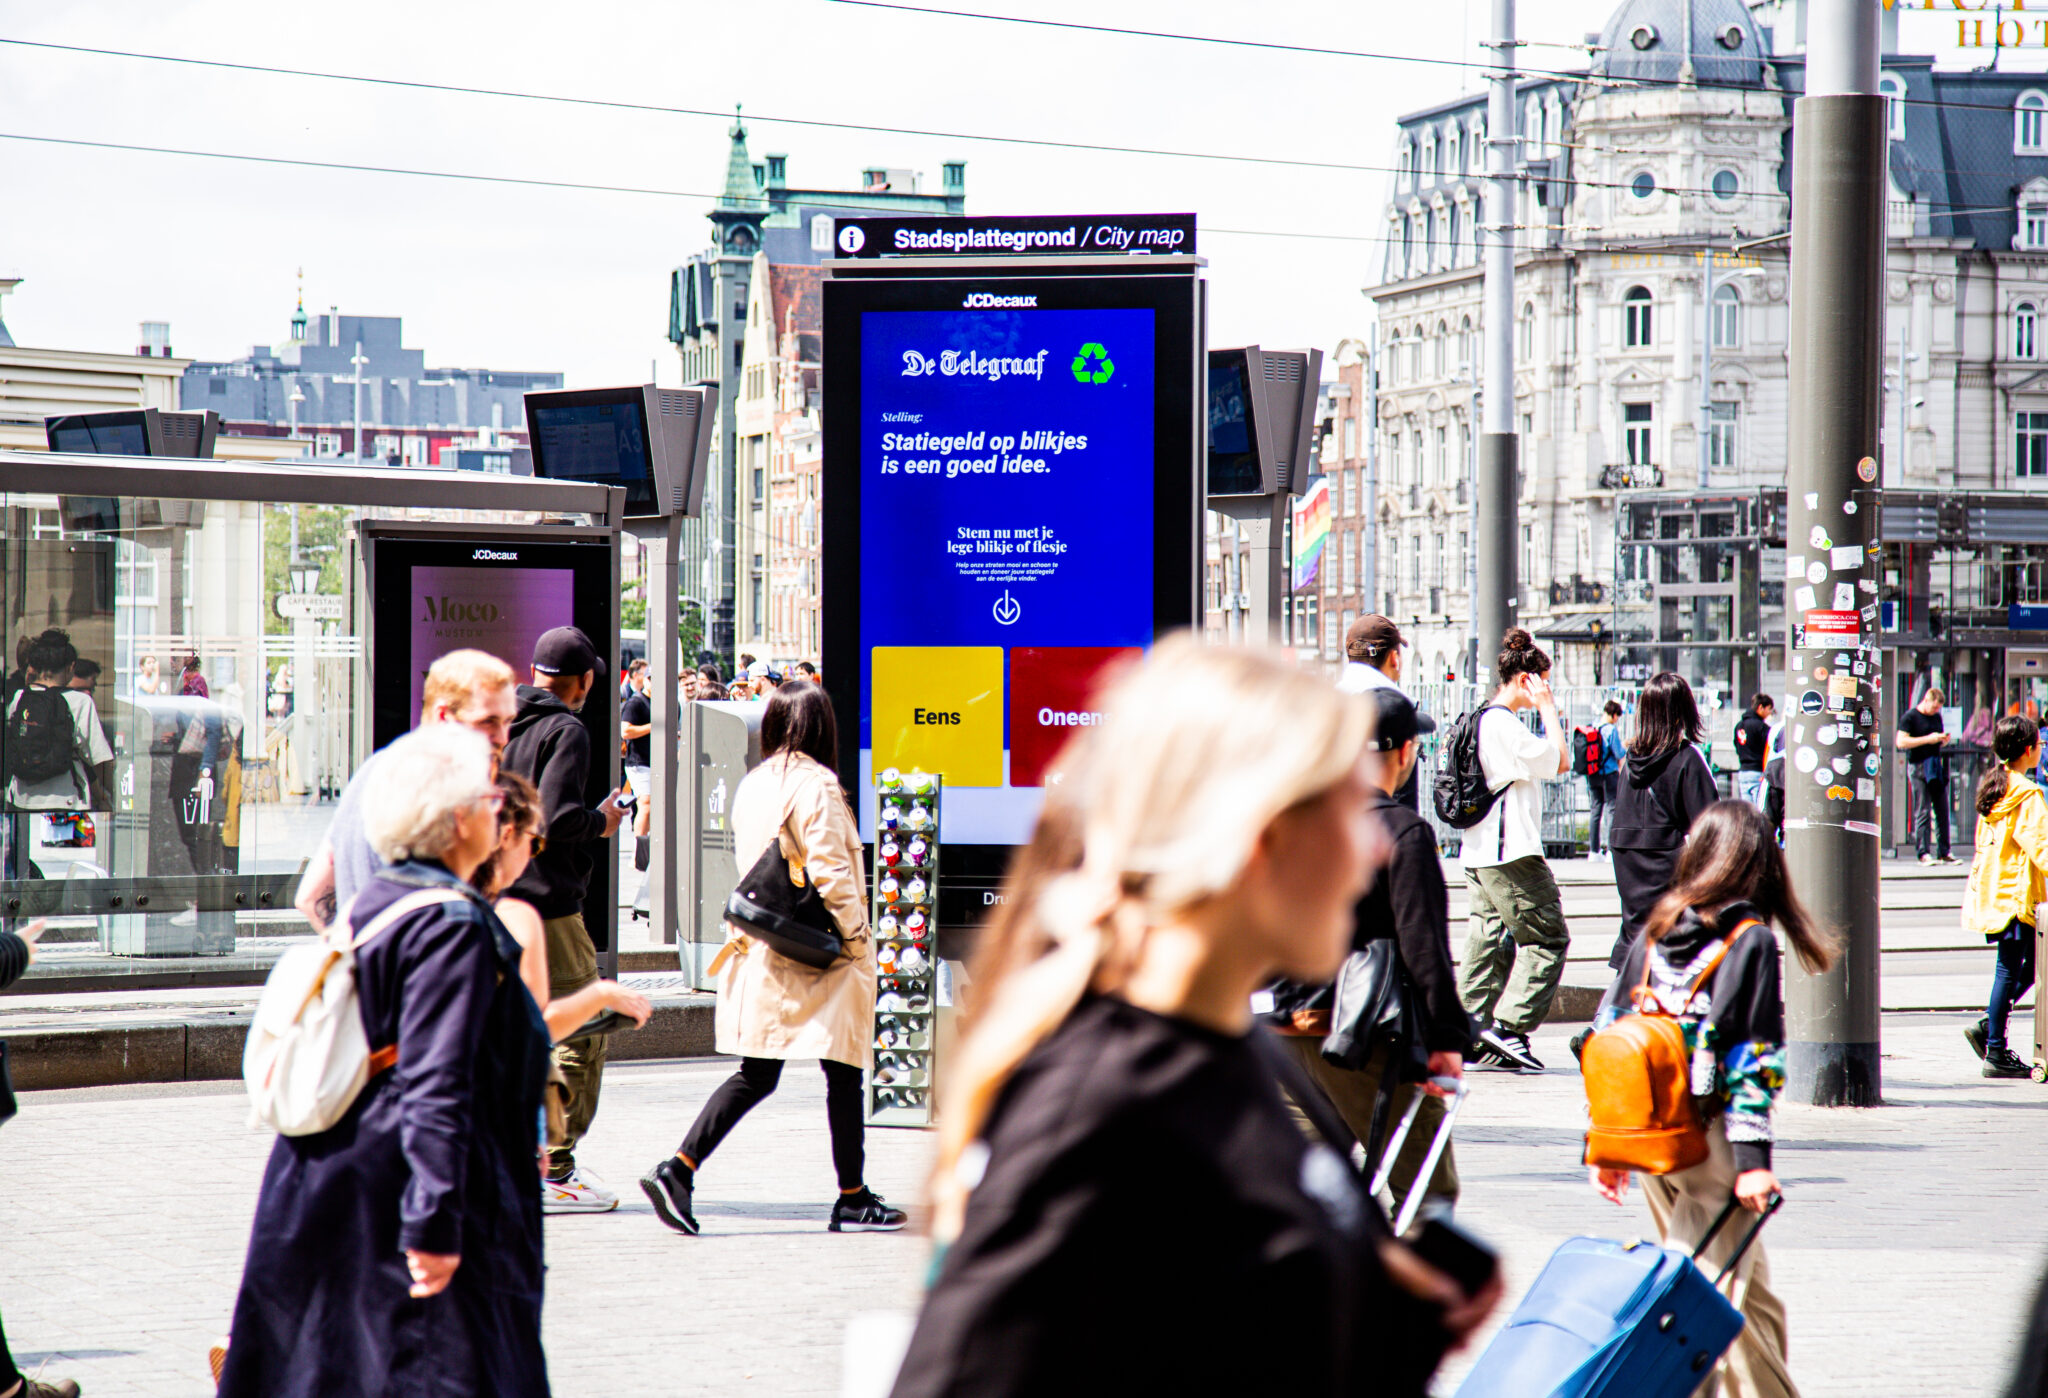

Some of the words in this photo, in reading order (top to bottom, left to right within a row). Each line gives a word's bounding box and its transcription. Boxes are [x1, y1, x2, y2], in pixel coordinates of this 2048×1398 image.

[894, 227, 1076, 251] Stadsplattegrond
[1094, 226, 1134, 249] City
[1137, 229, 1185, 249] map
[1611, 254, 1664, 269] HOTEL
[1695, 251, 1763, 268] VCTORIA
[962, 293, 1038, 308] JCDecaux
[901, 349, 936, 377] De
[939, 348, 1049, 381] Telegraaf
[880, 411, 924, 424] Stelling:
[618, 427, 643, 454] A3
[880, 430, 985, 456] Statiegeld
[989, 435, 1015, 455] op
[1017, 430, 1088, 455] blikjes
[880, 455, 900, 475] is
[904, 458, 942, 475] een
[945, 454, 998, 478] goed
[1001, 454, 1051, 475] idee.
[957, 526, 991, 539] Stem
[993, 528, 1011, 539] nu
[1014, 527, 1039, 539] met
[1040, 525, 1054, 541] je
[472, 549, 518, 561] JCDecaux
[947, 540, 974, 556] lege
[976, 540, 1014, 556] blikje
[1016, 540, 1030, 553] of
[1032, 540, 1068, 556] flesje
[955, 561, 970, 569] Help
[1010, 568, 1026, 576] jouw
[1026, 568, 1055, 576] statiegeld
[996, 575, 1018, 583] eerlijke
[421, 595, 499, 624] Moco
[434, 628, 484, 639] MUSEUM
[914, 707, 961, 726] Eens
[983, 891, 1010, 906] Dru
